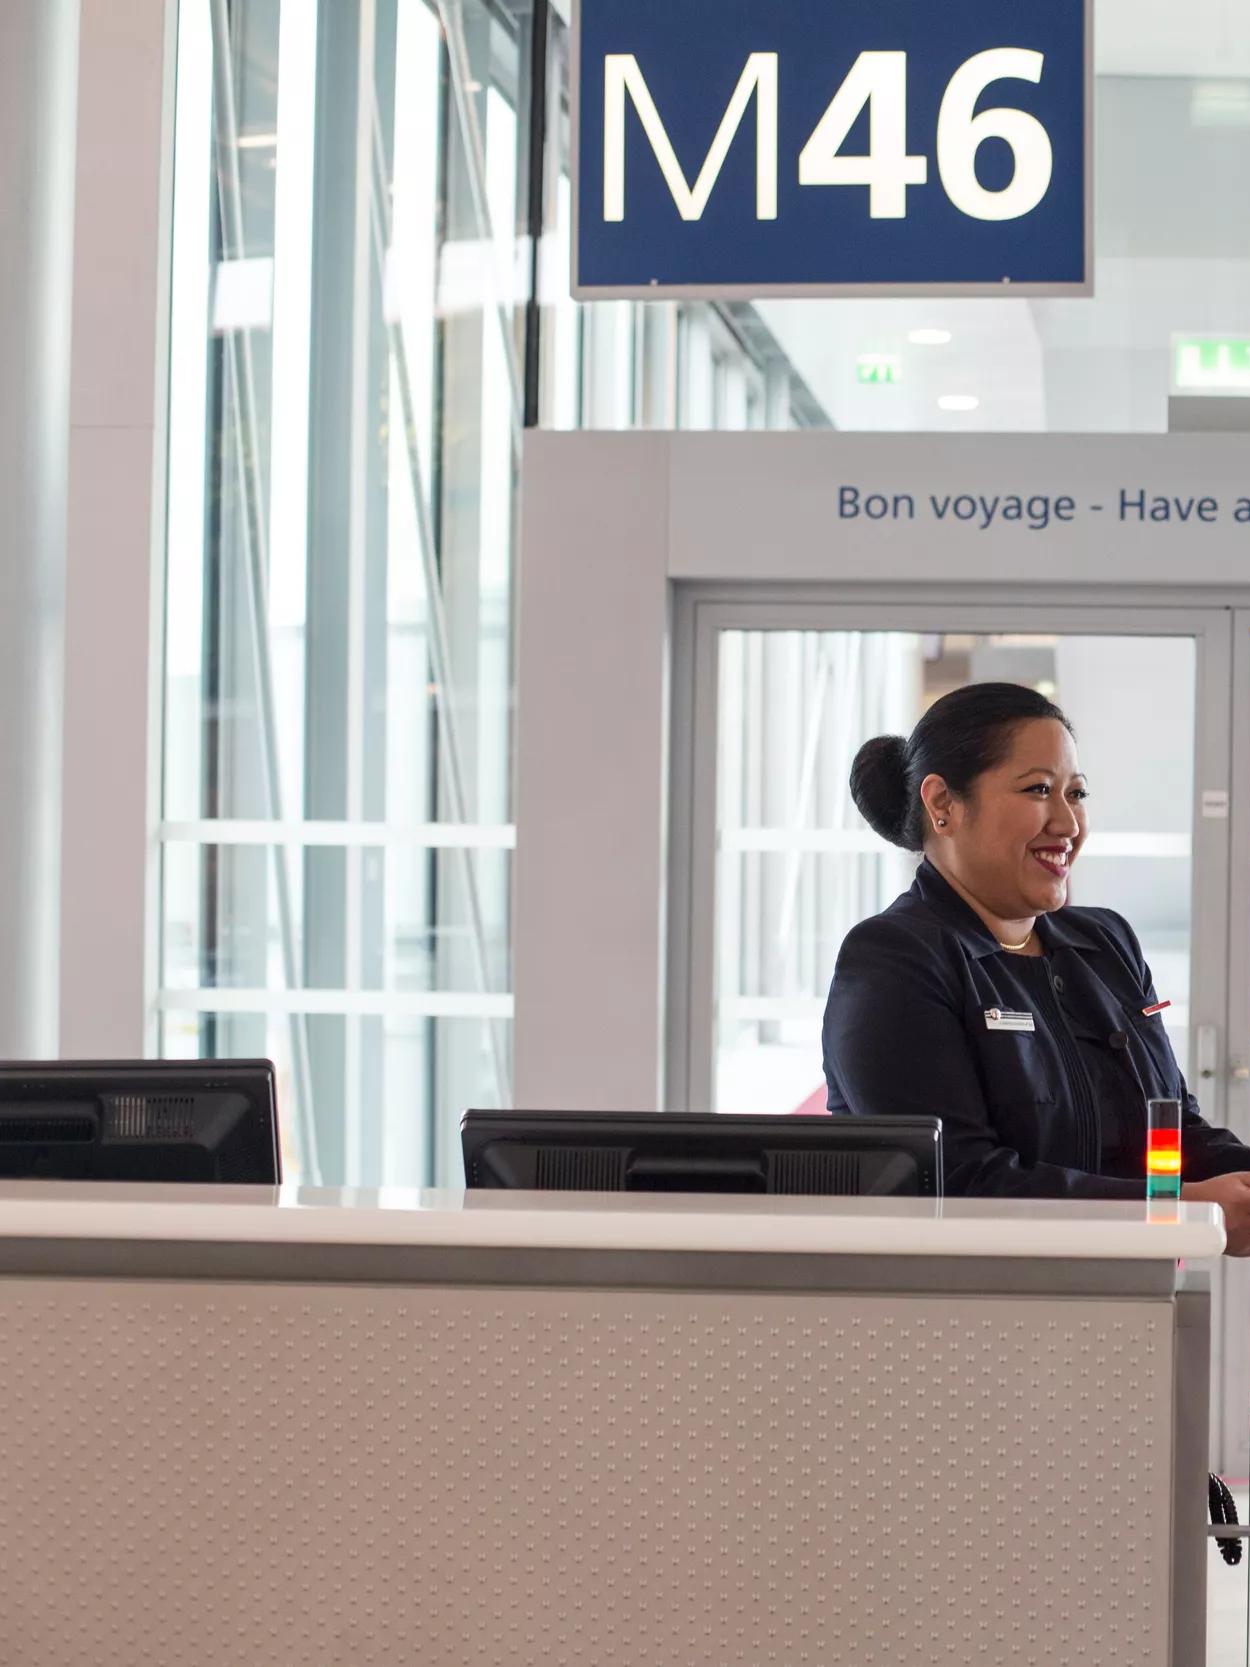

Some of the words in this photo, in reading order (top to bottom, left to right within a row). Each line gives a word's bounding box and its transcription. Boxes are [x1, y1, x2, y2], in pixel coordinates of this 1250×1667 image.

[603, 47, 1053, 222] M46
[839, 487, 914, 519] Bon
[930, 494, 1076, 529] voyage
[1118, 489, 1219, 522] Have
